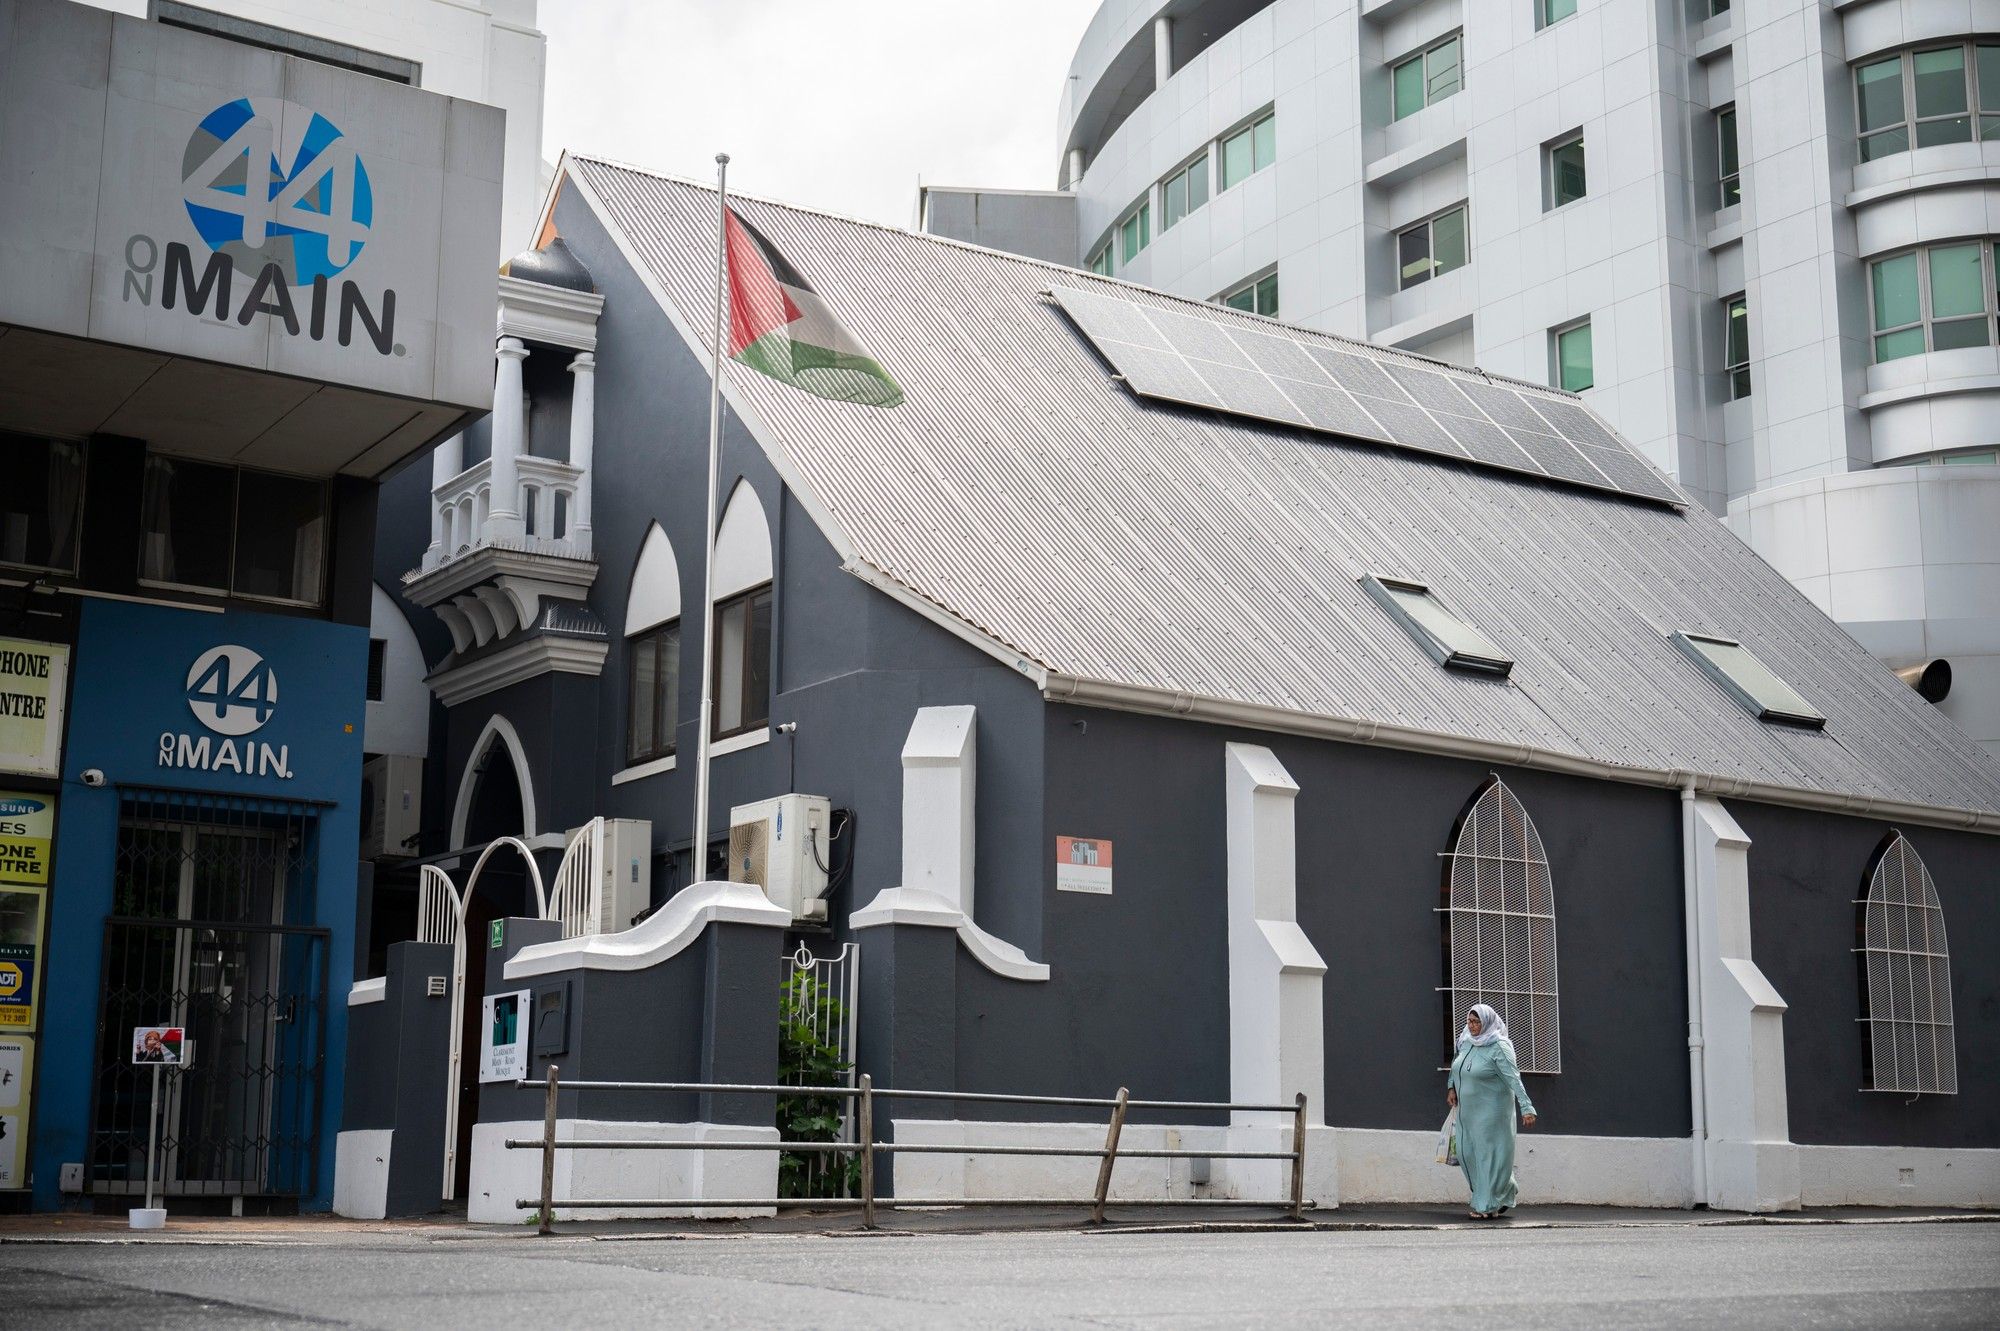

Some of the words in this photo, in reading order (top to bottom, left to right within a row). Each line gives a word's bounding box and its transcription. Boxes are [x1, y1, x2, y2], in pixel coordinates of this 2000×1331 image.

[181, 110, 372, 268] 44
[123, 234, 158, 306] ON
[186, 652, 278, 725] 44
[159, 732, 176, 767] ON
